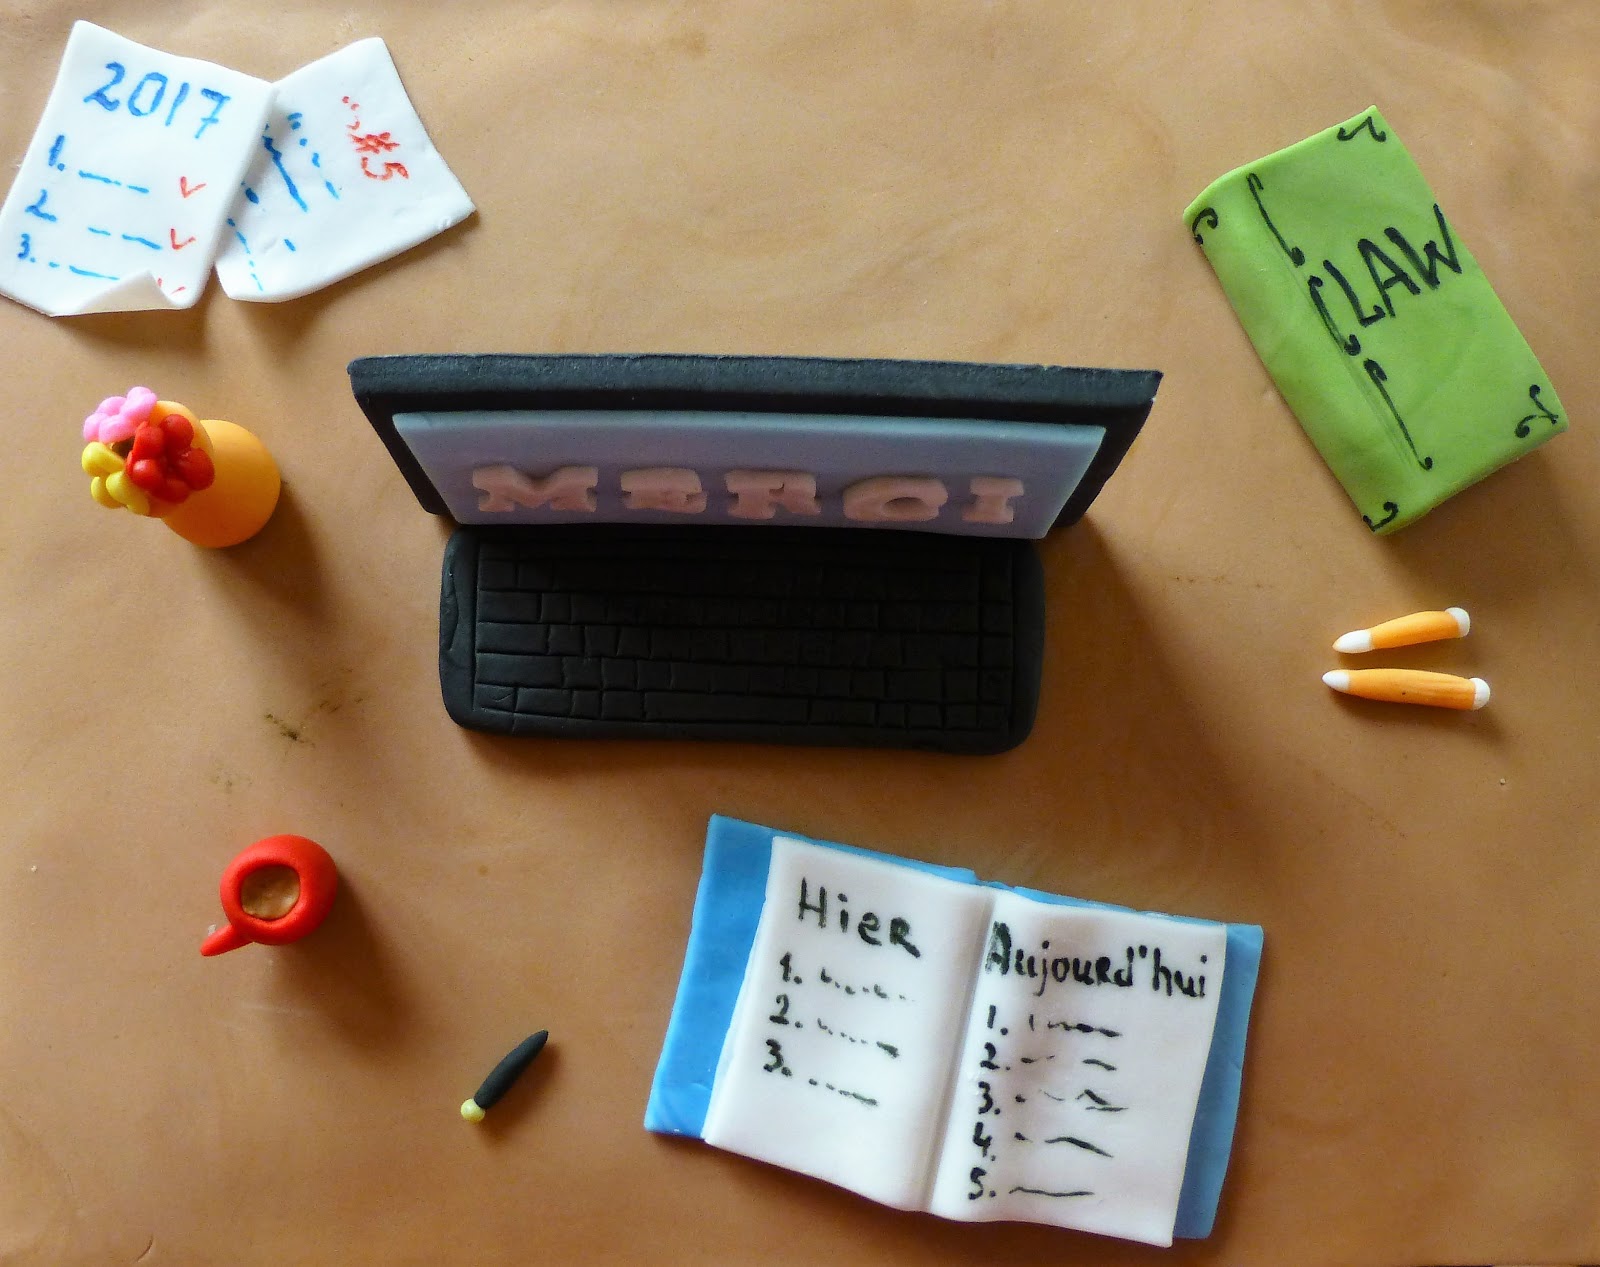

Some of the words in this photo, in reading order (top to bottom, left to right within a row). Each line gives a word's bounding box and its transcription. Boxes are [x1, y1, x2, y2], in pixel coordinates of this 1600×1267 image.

[85, 62, 231, 139] 2017
[49, 135, 65, 171] 1.
[18, 233, 36, 263] 3.
[1323, 203, 1462, 327] LAW
[472, 465, 1024, 524] MERCI
[780, 952, 803, 984] 1.
[769, 993, 803, 1029] 2.
[987, 1005, 1008, 1036] 1.
[764, 1038, 792, 1077] 3.
[980, 1042, 1011, 1070] 2.
[978, 1081, 1001, 1115] 3.
[973, 1122, 996, 1162] 4.
[968, 1167, 997, 1200] 5.
